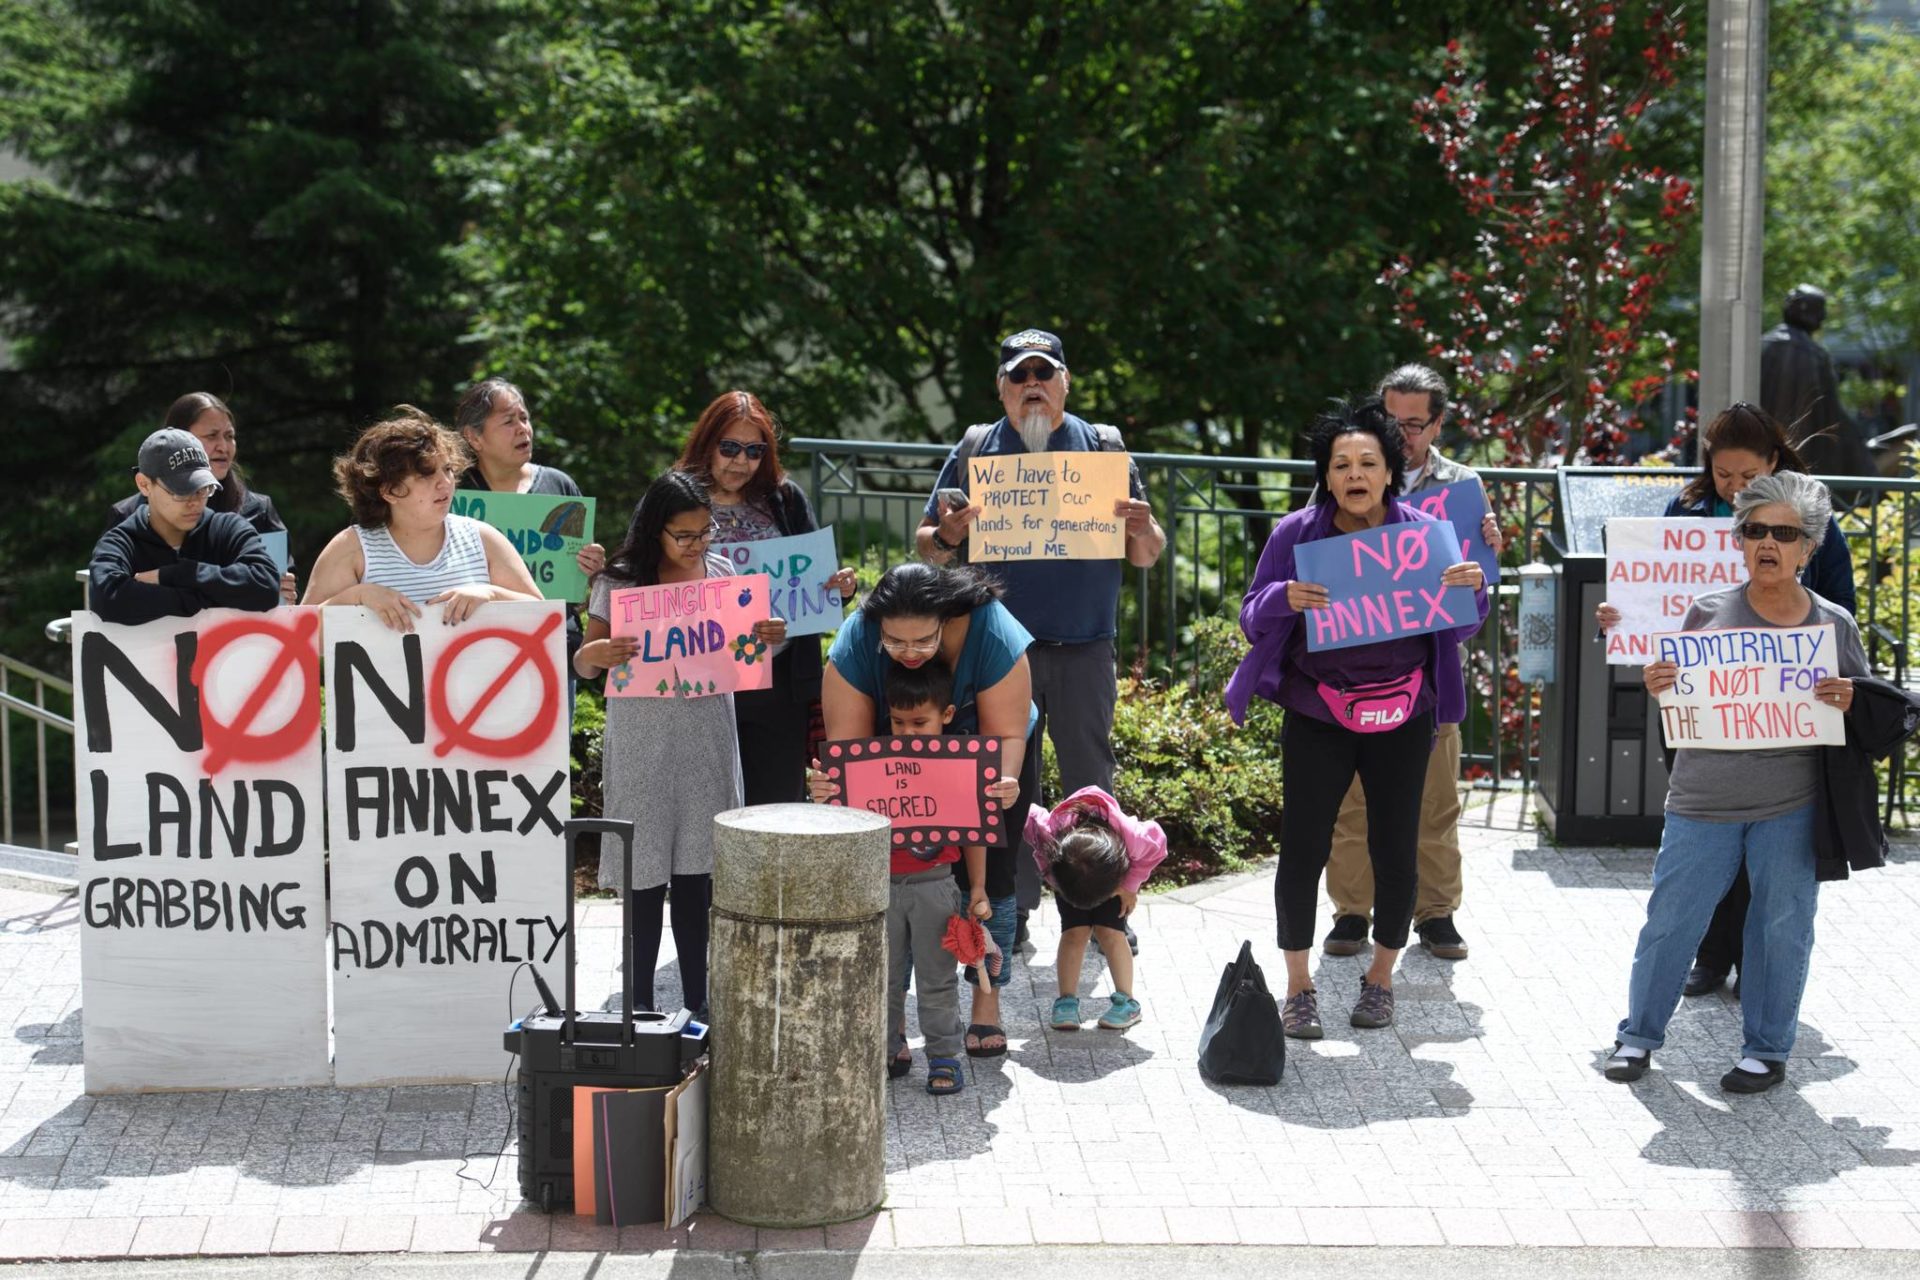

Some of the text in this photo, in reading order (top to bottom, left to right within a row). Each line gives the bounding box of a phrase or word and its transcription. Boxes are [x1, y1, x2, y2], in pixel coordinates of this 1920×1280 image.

[973, 458, 1081, 484] We have to
[1614, 475, 1685, 487] TRASH
[982, 489, 1092, 506] PROTECT our
[975, 514, 1117, 543] lands for generations
[1664, 529, 1706, 550] NO
[984, 542, 1068, 559] beyond ME
[1610, 562, 1743, 584] ADMIRAL
[618, 581, 730, 623] TLINGIT
[1312, 586, 1455, 645] ANNEX
[642, 619, 725, 663] LAND
[1660, 630, 1825, 668] ADMIRALTY
[1360, 707, 1405, 726] FILA
[1661, 702, 1818, 741] THE TAKING
[885, 762, 922, 776] LAND
[896, 779, 908, 790] IS
[90, 769, 306, 861] LAND
[345, 766, 567, 840] ANNEX
[866, 796, 937, 818] SACRED
[394, 850, 497, 908] ON
[84, 877, 306, 932] GRABBING
[331, 915, 567, 970] ADMIRALTY
